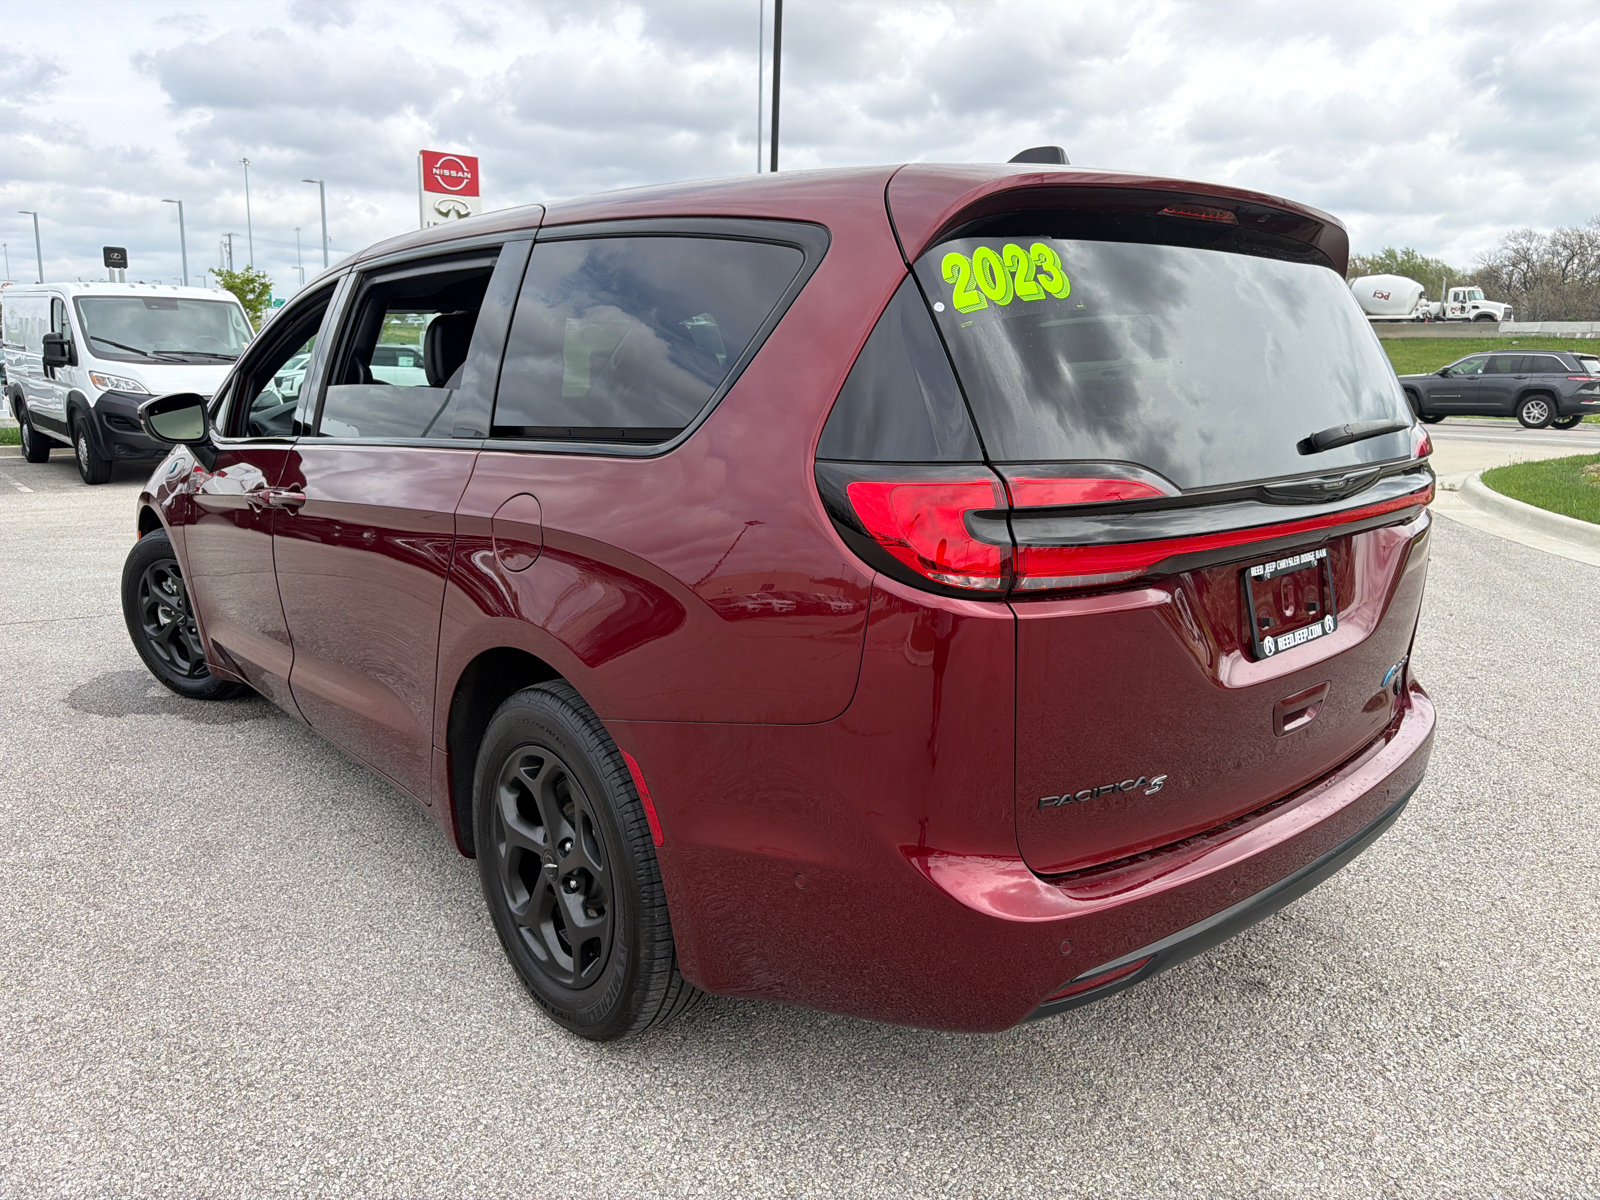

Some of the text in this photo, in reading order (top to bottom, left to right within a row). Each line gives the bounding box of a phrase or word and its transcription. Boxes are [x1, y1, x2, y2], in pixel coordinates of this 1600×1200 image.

[432, 168, 472, 179] NISSAN
[941, 242, 1071, 314] 2023
[1372, 291, 1391, 301] PCI
[1250, 547, 1327, 577] REED JEEP CHRYSLER DODGE RAM
[1277, 623, 1322, 651] REEDJEEP.COM
[1037, 774, 1168, 811] PACIFICA S
